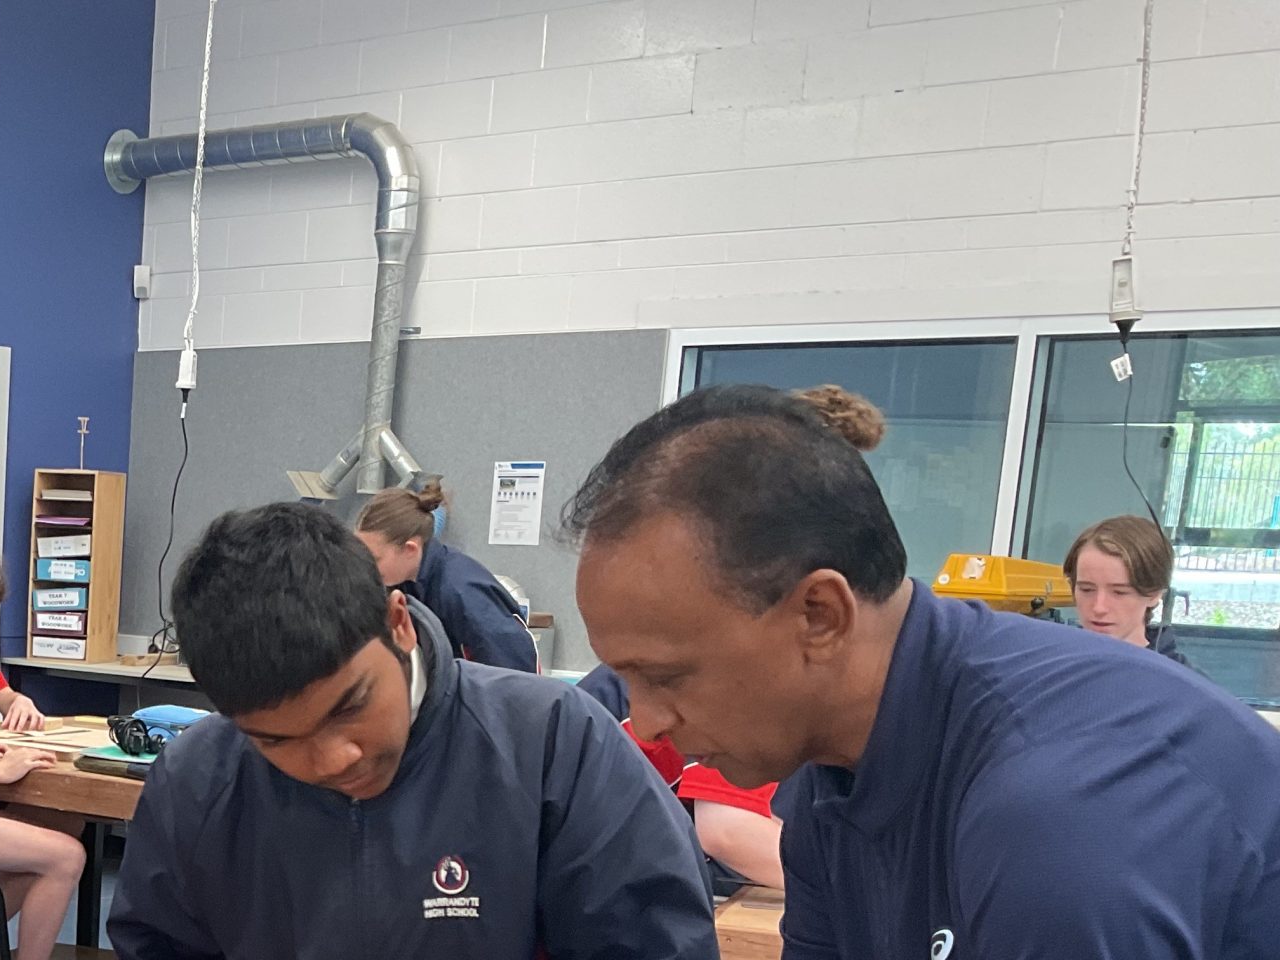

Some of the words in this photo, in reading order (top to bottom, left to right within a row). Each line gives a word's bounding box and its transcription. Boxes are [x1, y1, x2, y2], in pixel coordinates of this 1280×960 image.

[423, 897, 480, 908] WARRANDYTE
[424, 908, 445, 918] HIGH
[446, 908, 479, 917] SCHOOL
